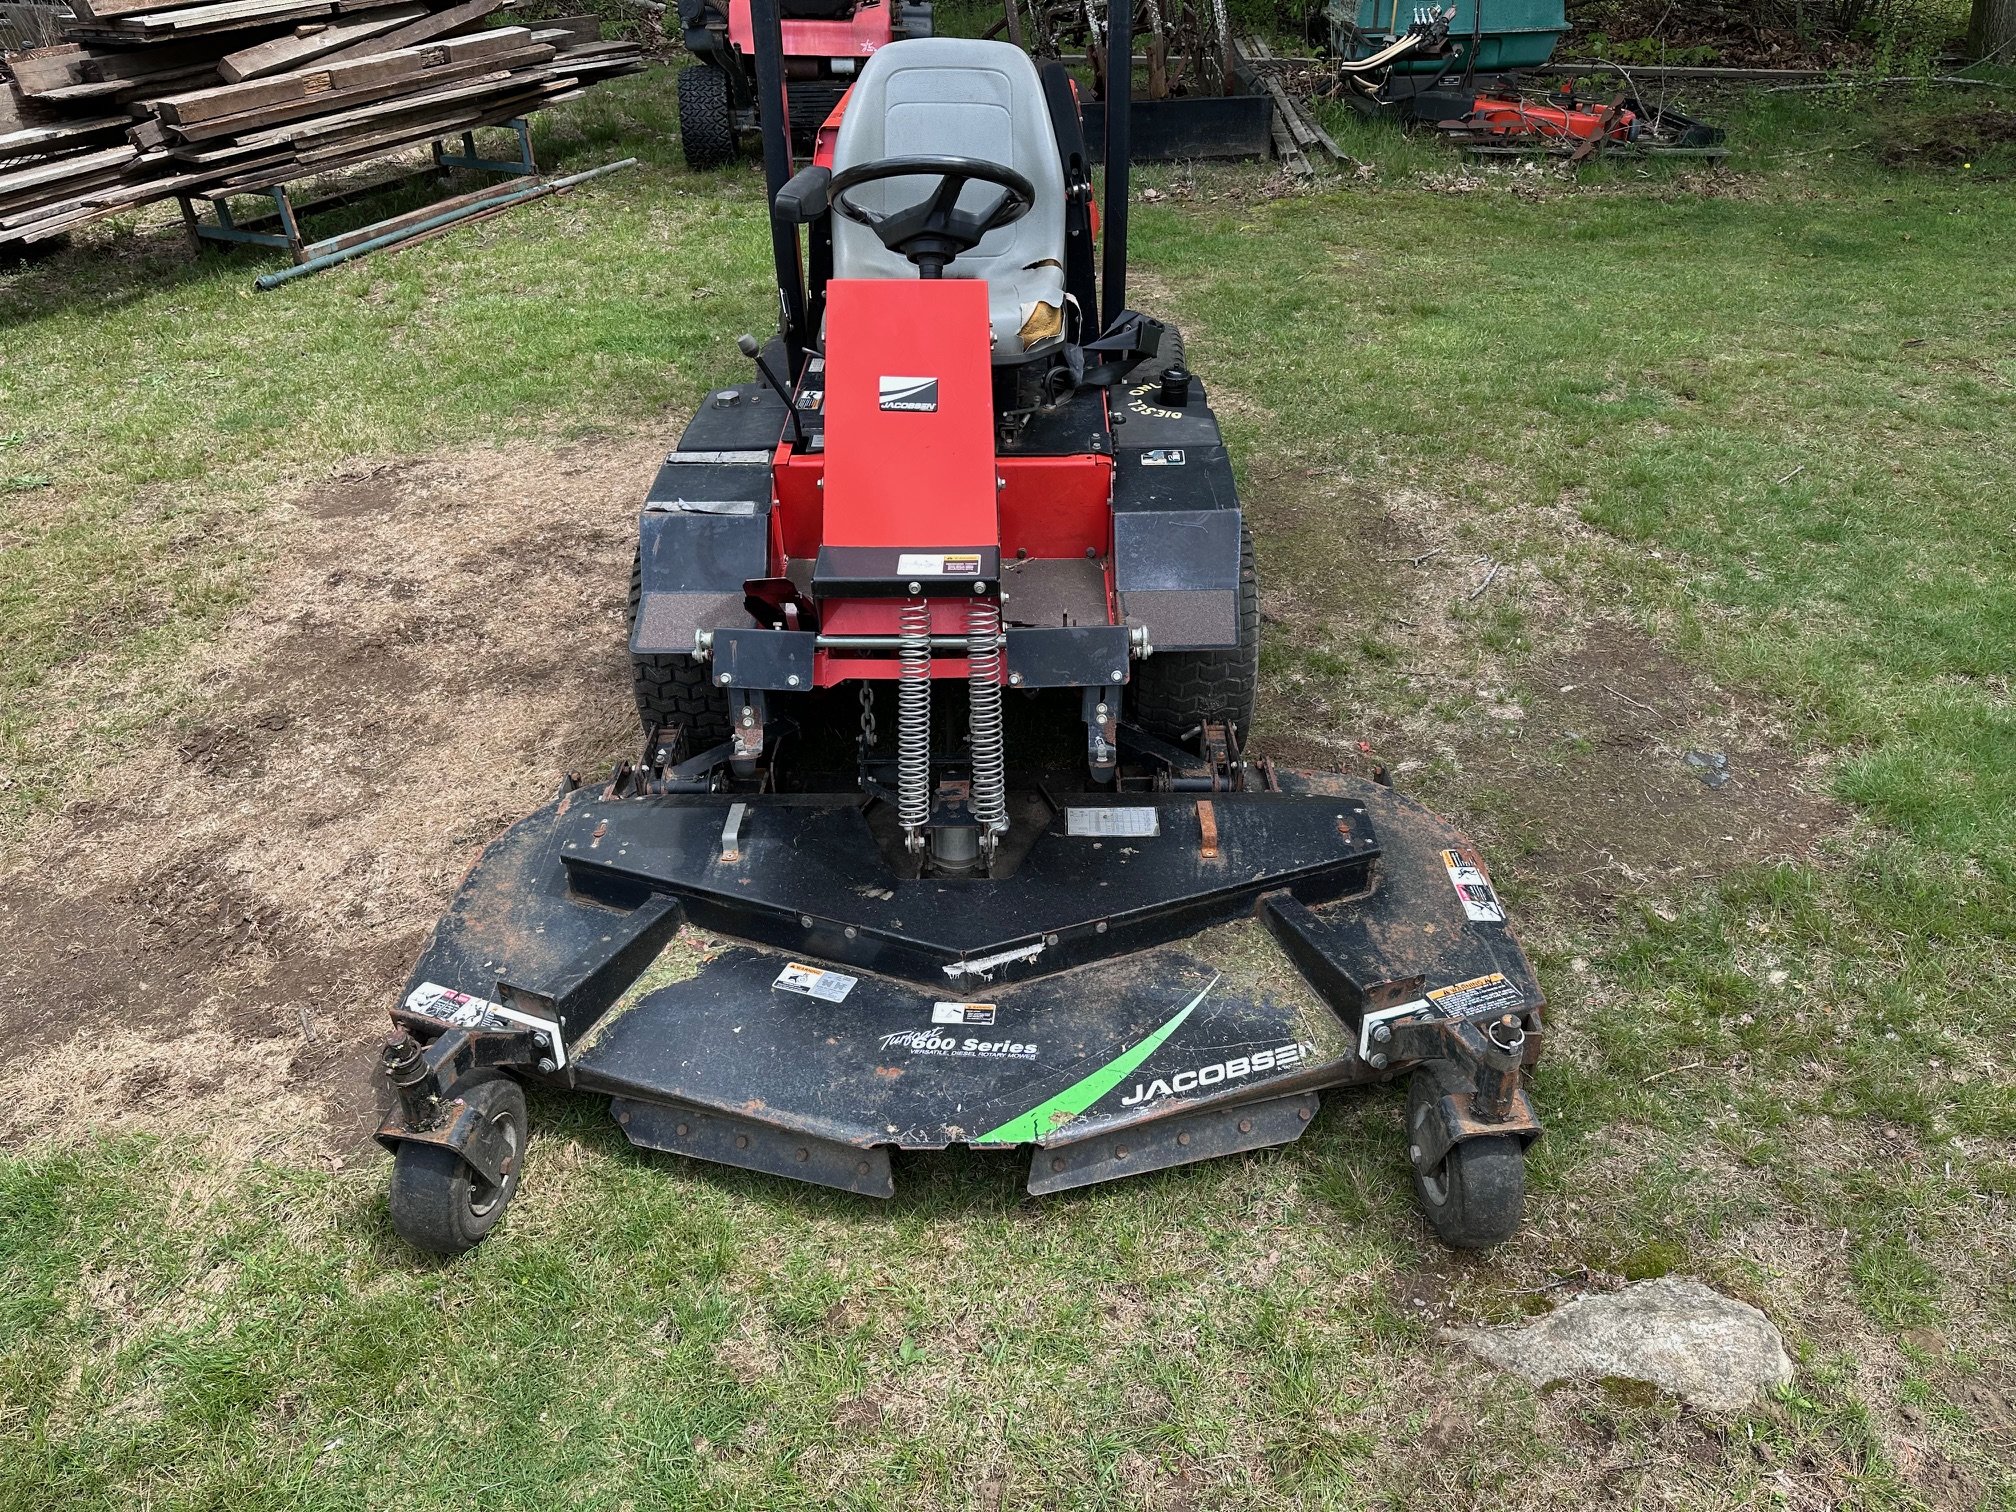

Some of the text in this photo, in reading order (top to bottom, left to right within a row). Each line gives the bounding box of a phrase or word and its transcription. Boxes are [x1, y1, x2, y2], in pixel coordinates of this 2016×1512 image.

[1128, 380, 1163, 396] ONL
[880, 401, 937, 412] JACOBSEN
[1127, 399, 1183, 420] DIESEL
[878, 1026, 945, 1051] Turfcat
[911, 1037, 1038, 1054] 600 Series
